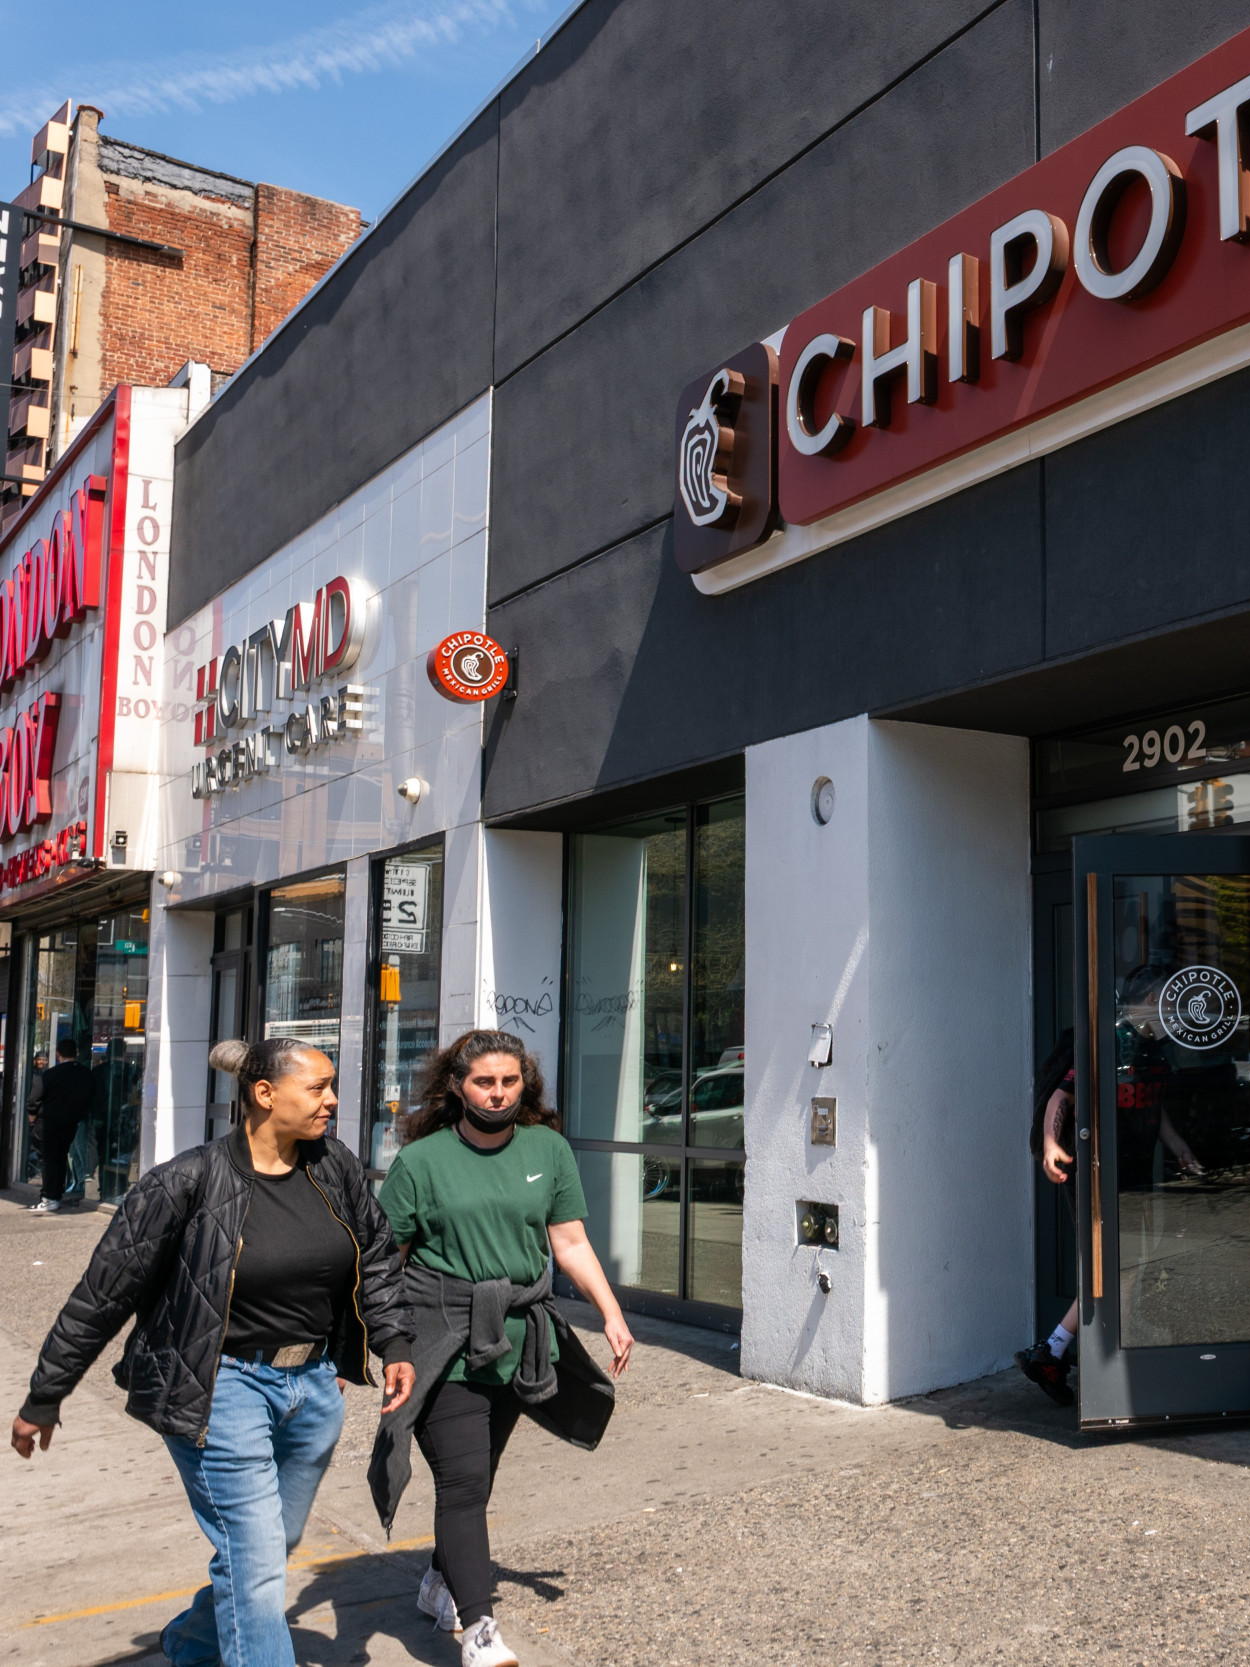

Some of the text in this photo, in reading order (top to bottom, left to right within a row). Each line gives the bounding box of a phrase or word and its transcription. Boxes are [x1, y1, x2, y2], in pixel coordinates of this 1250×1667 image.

[132, 479, 160, 687] LONDON
[218, 575, 366, 730] CITYMD
[441, 634, 505, 665] CHIPOTLE
[442, 668, 503, 696] MEXICAN GRILL
[117, 697, 163, 720] BOY
[191, 684, 363, 799] URGENT CARE
[1122, 720, 1206, 772] 2902
[1166, 971, 1234, 1002] CHIPOTLE
[1168, 1014, 1234, 1042] MEXICAN GRILL
